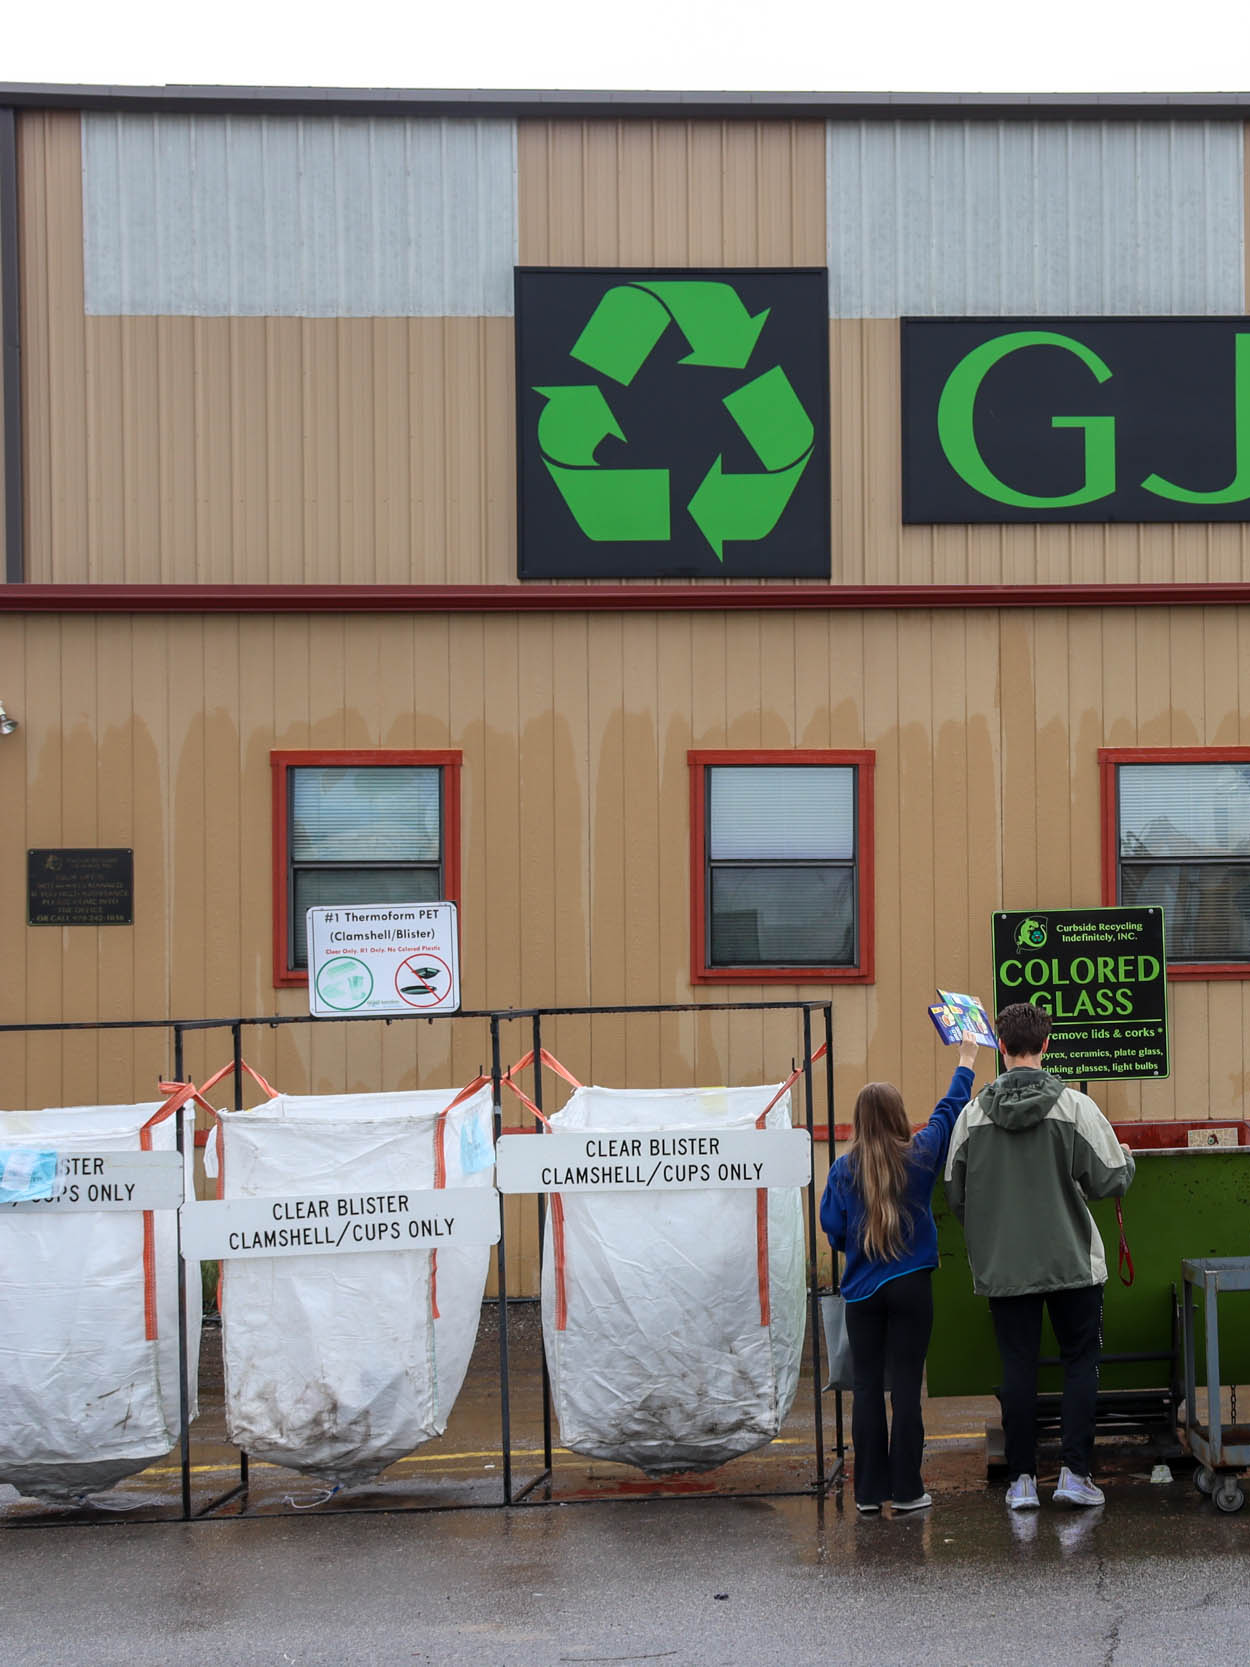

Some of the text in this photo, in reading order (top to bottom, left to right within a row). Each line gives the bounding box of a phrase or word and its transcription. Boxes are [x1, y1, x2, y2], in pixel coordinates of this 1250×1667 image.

[325, 909, 440, 923] #1 Thermoform PET
[1056, 922, 1143, 932] Curbside Recycling
[330, 928, 435, 943] (Clamshell/Blister)
[1062, 932, 1138, 943] Indefinitely, INC.
[1000, 955, 1160, 987] COLORED
[1029, 988, 1133, 1017] GLASS
[1048, 1027, 1155, 1040] remove lids & corks
[1070, 1049, 1112, 1058] ceramics,
[1114, 1048, 1136, 1057] plate
[1138, 1048, 1163, 1057] glass,
[1041, 1062, 1158, 1074] rinking glasses, light bulbs
[586, 1138, 719, 1157] CLEAR BLISTER
[541, 1161, 763, 1186] CLAMSHELL/CUPS ONLY
[88, 1184, 135, 1202] ONLY
[273, 1195, 409, 1220] CLEAR BLISTER
[229, 1218, 455, 1250] CLAMSHELL/CUPS ONLY
